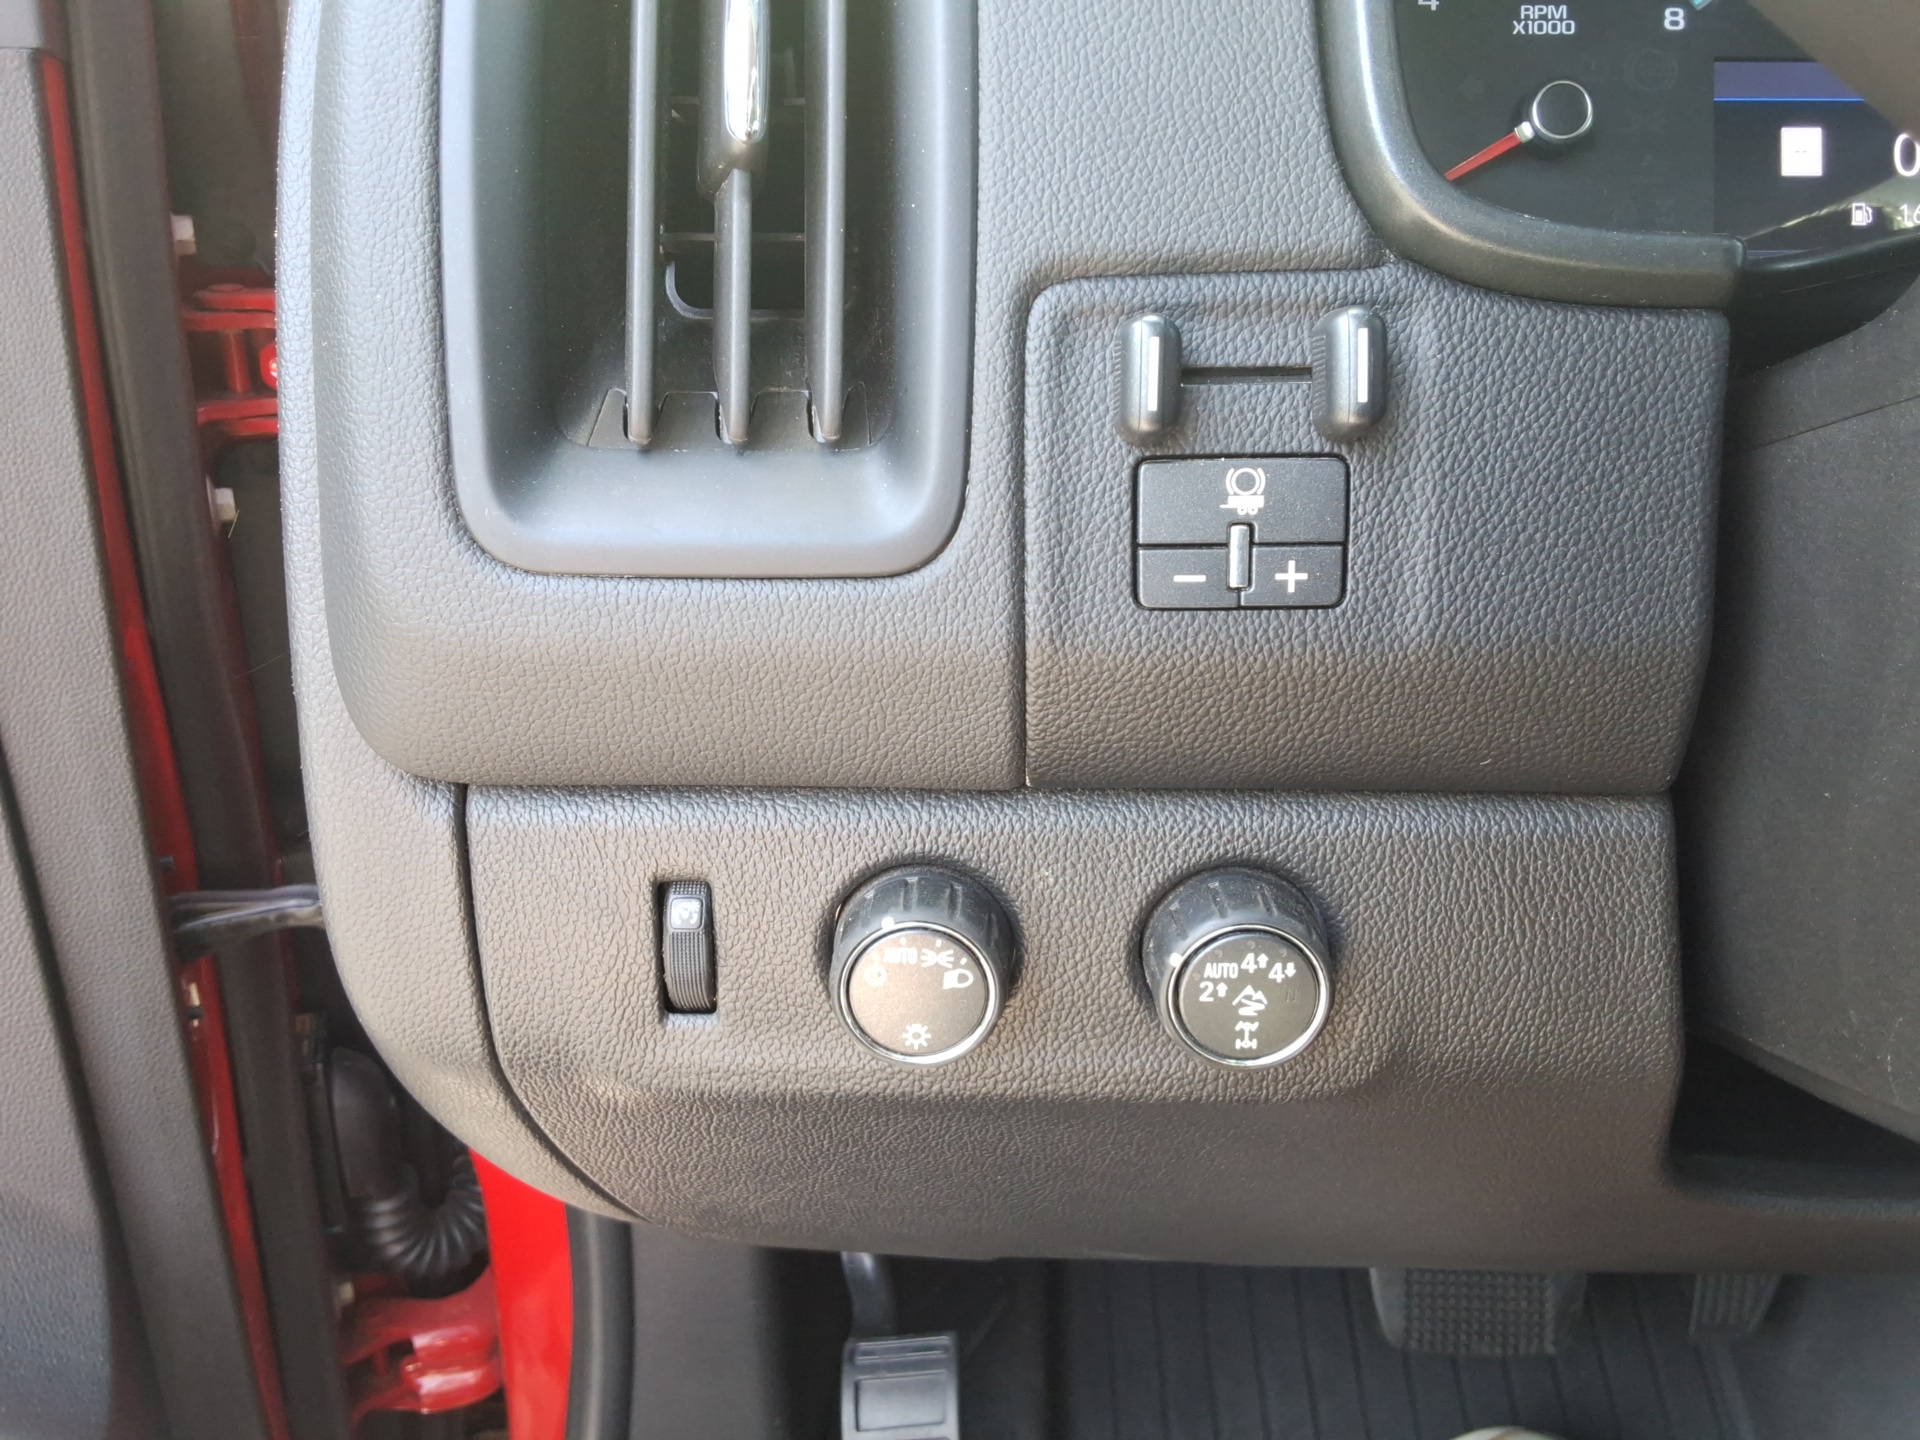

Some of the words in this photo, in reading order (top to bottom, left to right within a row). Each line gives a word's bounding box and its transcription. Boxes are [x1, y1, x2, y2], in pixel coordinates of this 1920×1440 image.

[1520, 5, 1567, 19] RPM
[1664, 7, 1685, 31] 8
[1512, 20, 1575, 35] X1000
[1204, 962, 1239, 979] AUTO
